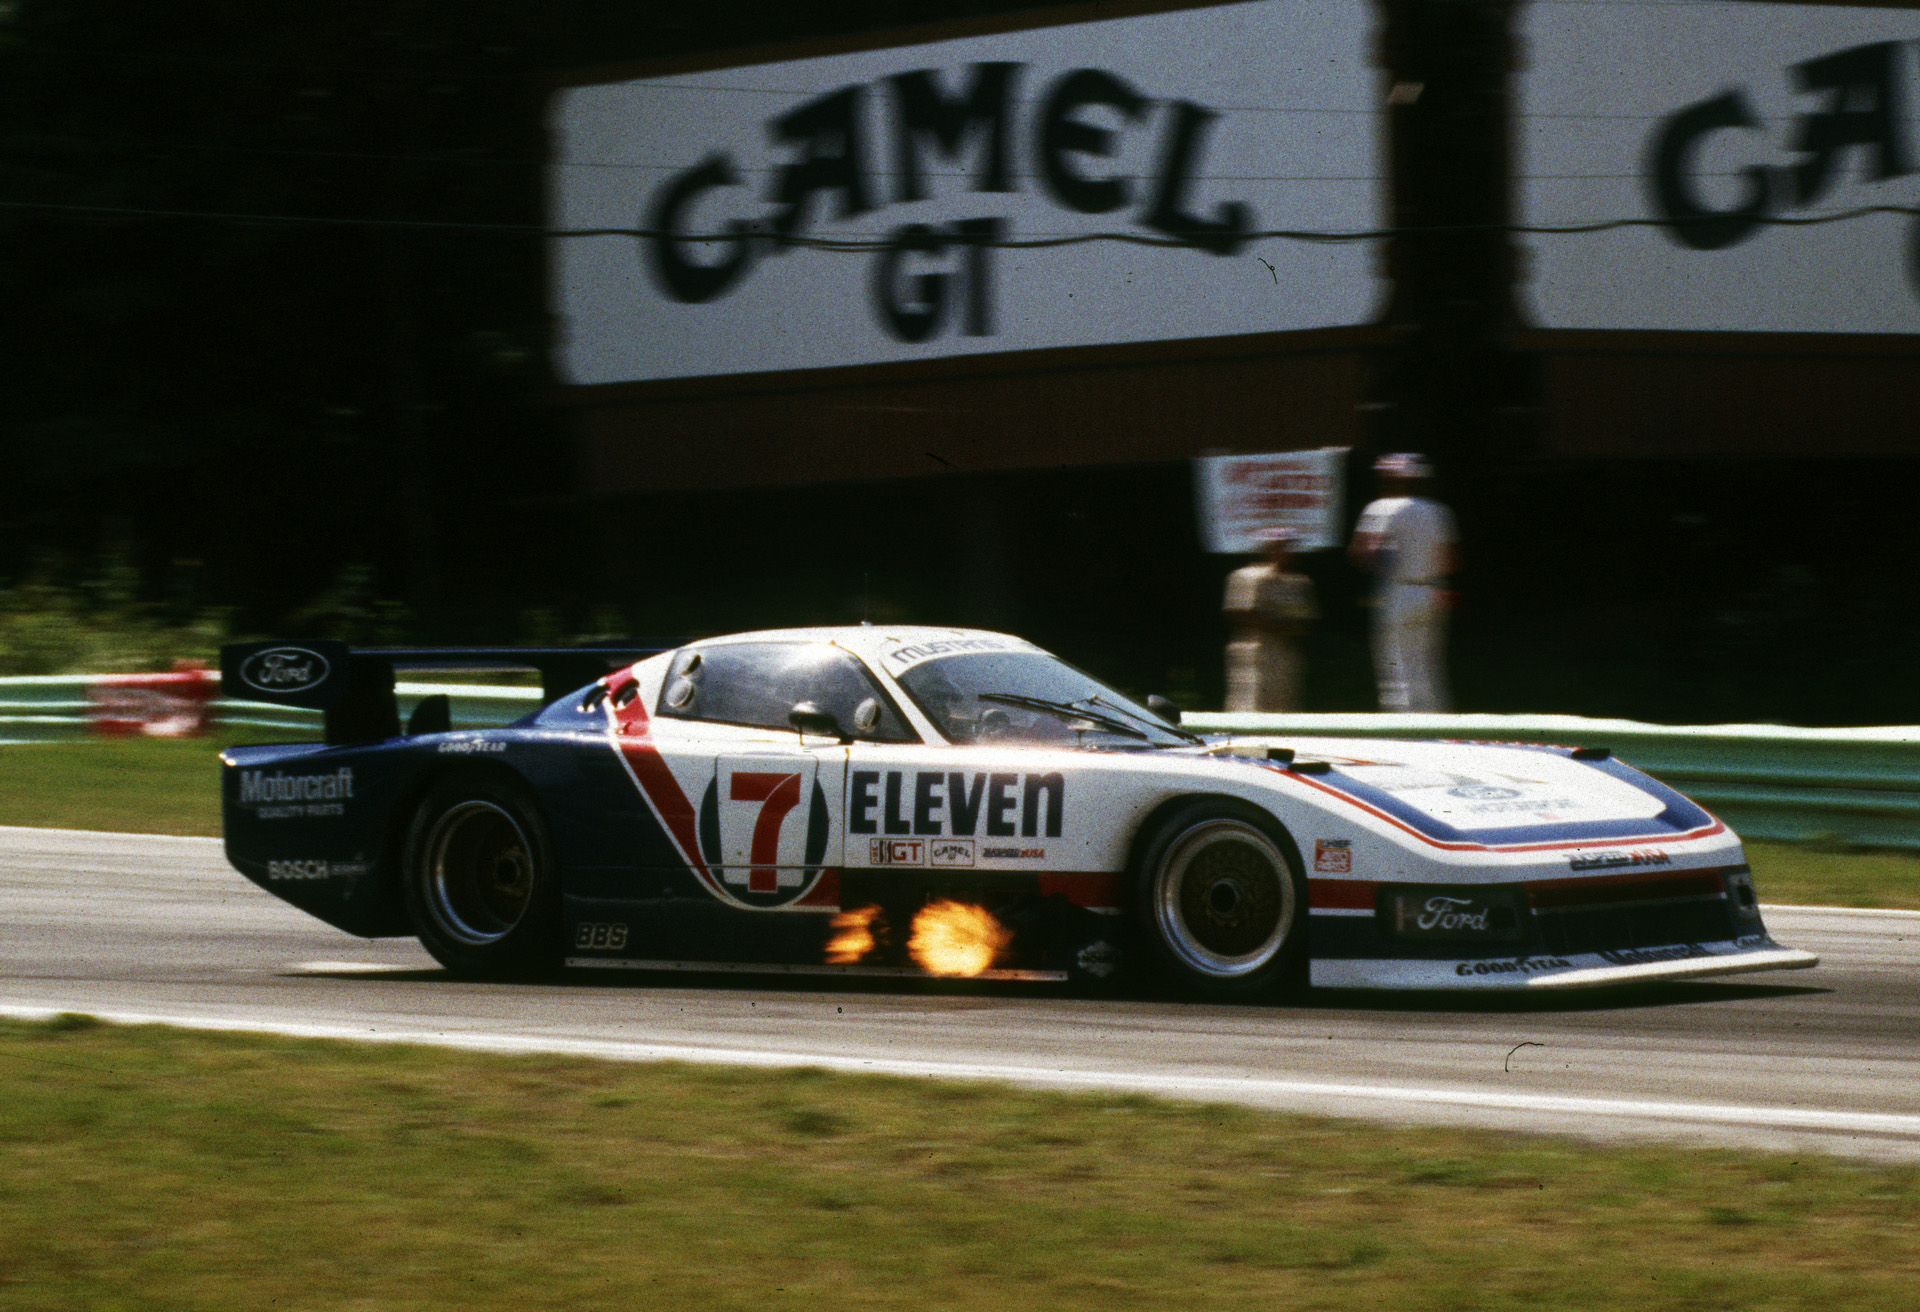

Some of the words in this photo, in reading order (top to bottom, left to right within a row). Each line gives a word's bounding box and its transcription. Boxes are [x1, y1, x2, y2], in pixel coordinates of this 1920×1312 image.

[646, 61, 1250, 303] CAMEL
[872, 217, 1004, 343] GT
[259, 653, 312, 683] Ford
[241, 767, 354, 802] Motorcraft
[730, 772, 801, 893] 7
[268, 860, 328, 879] BOSCH
[1418, 896, 1489, 930] Ford
[576, 921, 629, 949] BBS
